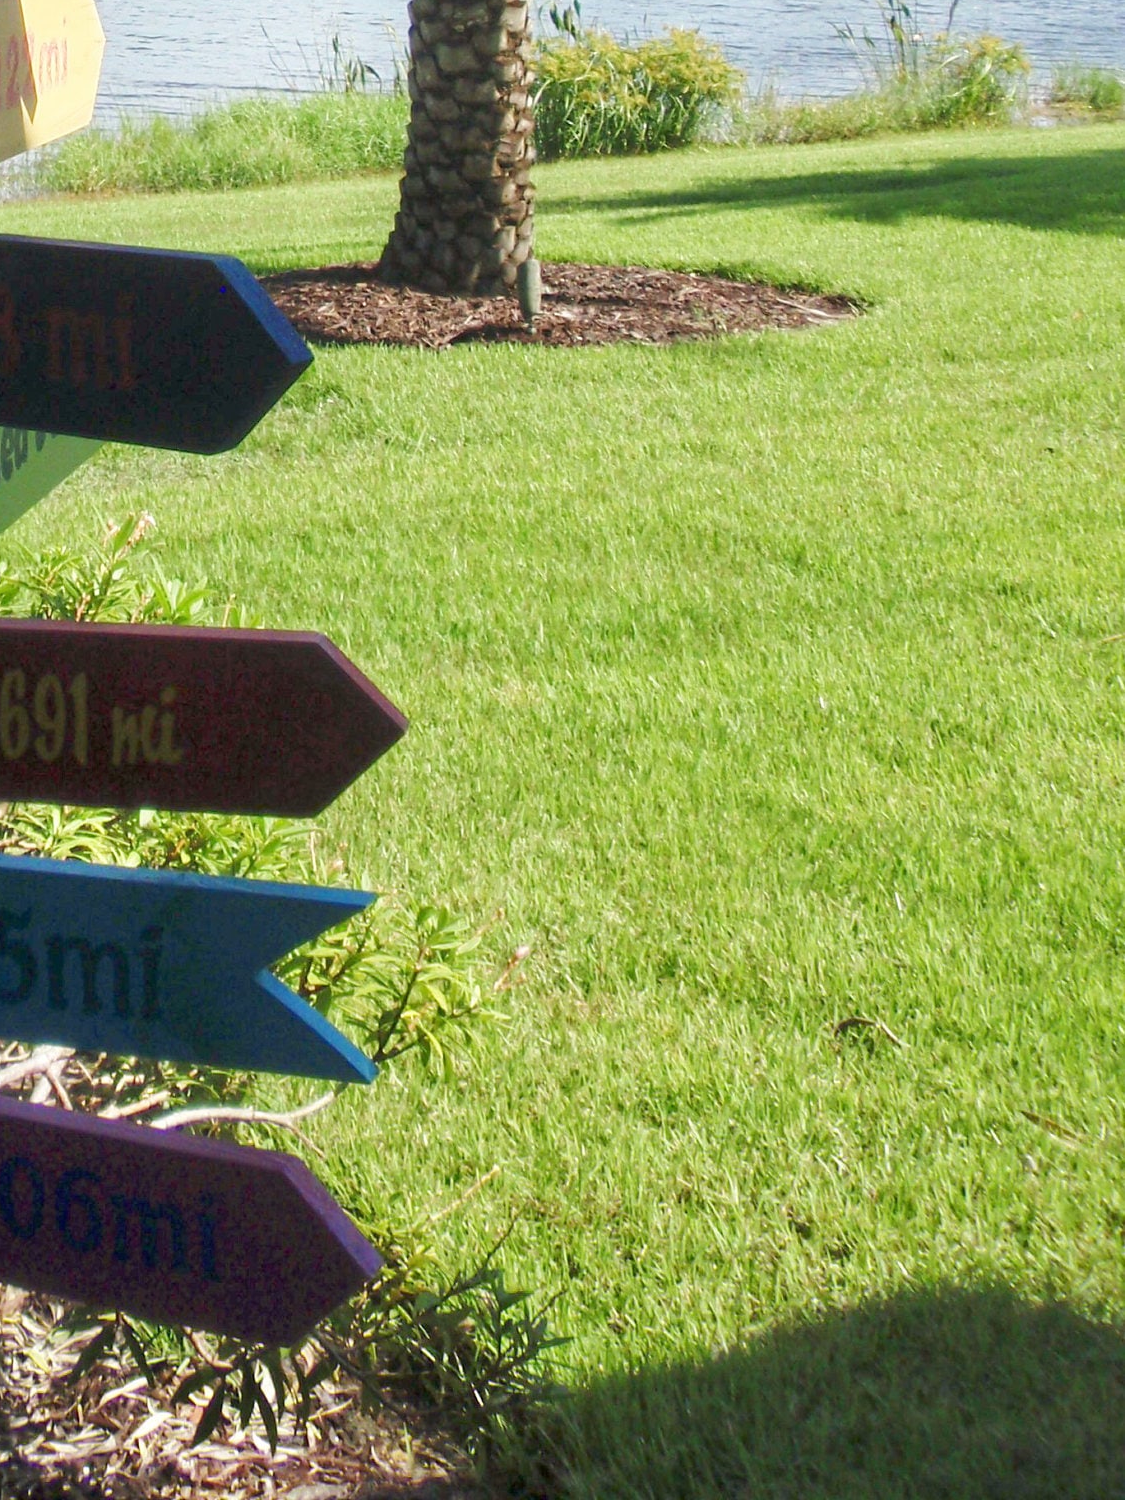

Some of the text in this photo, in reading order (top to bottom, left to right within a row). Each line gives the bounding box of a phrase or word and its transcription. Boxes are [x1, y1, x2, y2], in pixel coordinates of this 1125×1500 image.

[38, 16, 68, 95] mi
[44, 293, 135, 390] mi
[112, 685, 183, 766] mi
